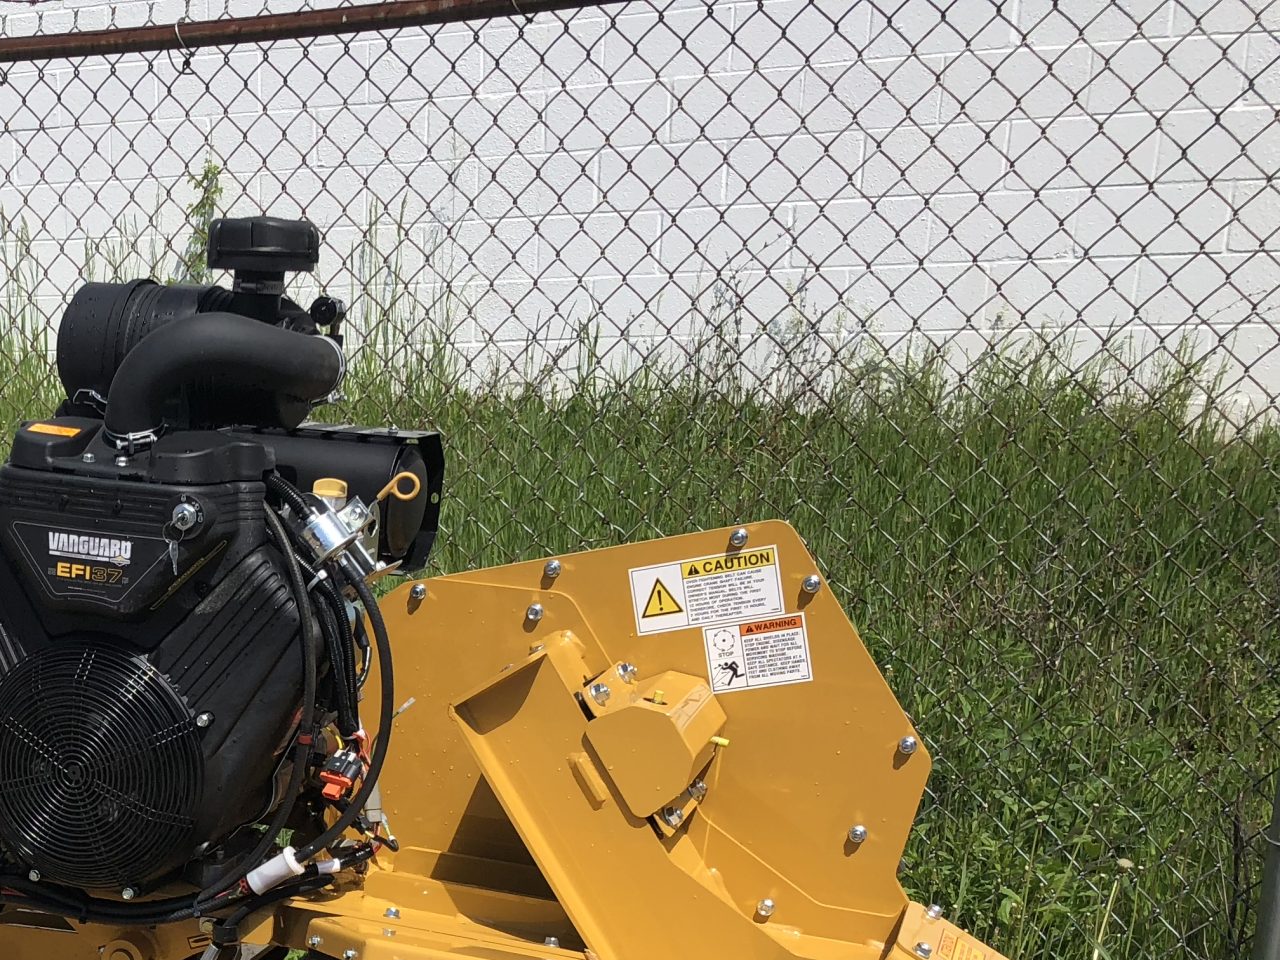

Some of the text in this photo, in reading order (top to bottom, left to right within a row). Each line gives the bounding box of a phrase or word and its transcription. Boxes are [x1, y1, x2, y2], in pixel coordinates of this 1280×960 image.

[48, 531, 132, 559] VANGUARD
[702, 552, 770, 572] CAUTION
[754, 618, 796, 632] WARNING
[718, 650, 734, 658] STOP
